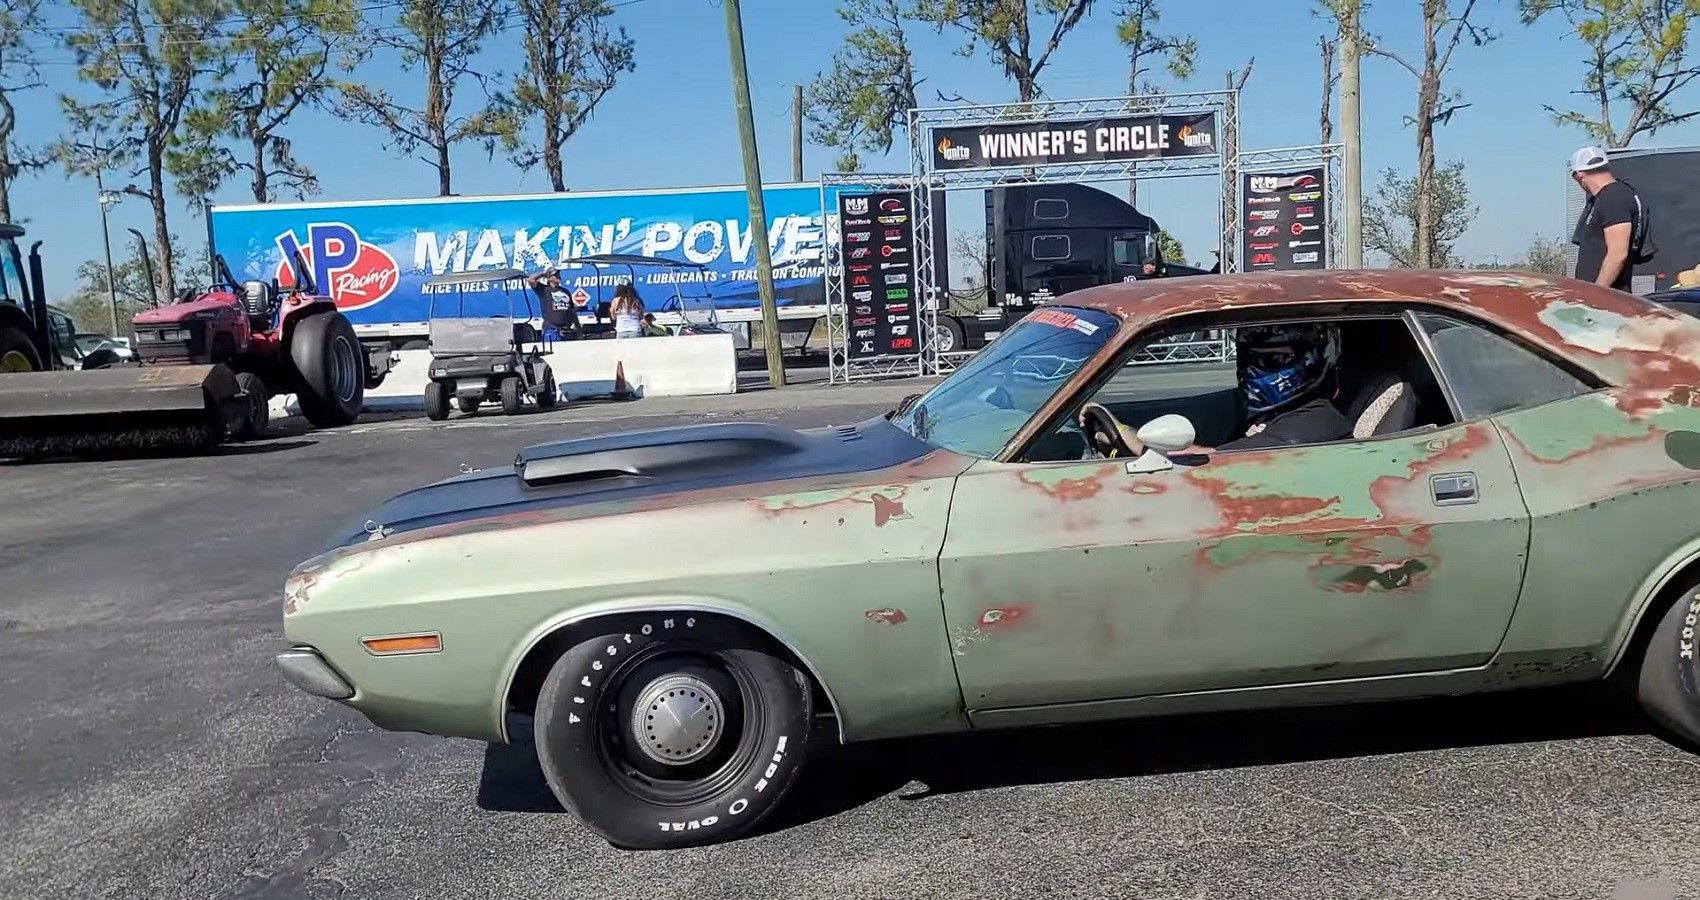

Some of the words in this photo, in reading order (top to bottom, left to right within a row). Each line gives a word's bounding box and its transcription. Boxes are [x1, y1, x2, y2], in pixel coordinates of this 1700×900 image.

[979, 129, 1088, 159] WINNER'S
[1095, 124, 1170, 152] CIRCLE
[275, 222, 361, 297] VP
[336, 268, 396, 301] Racing
[421, 282, 452, 295] RACE
[646, 270, 719, 284] LUBRICANTS
[731, 268, 788, 281] TRACON
[658, 815, 719, 832] OVAL
